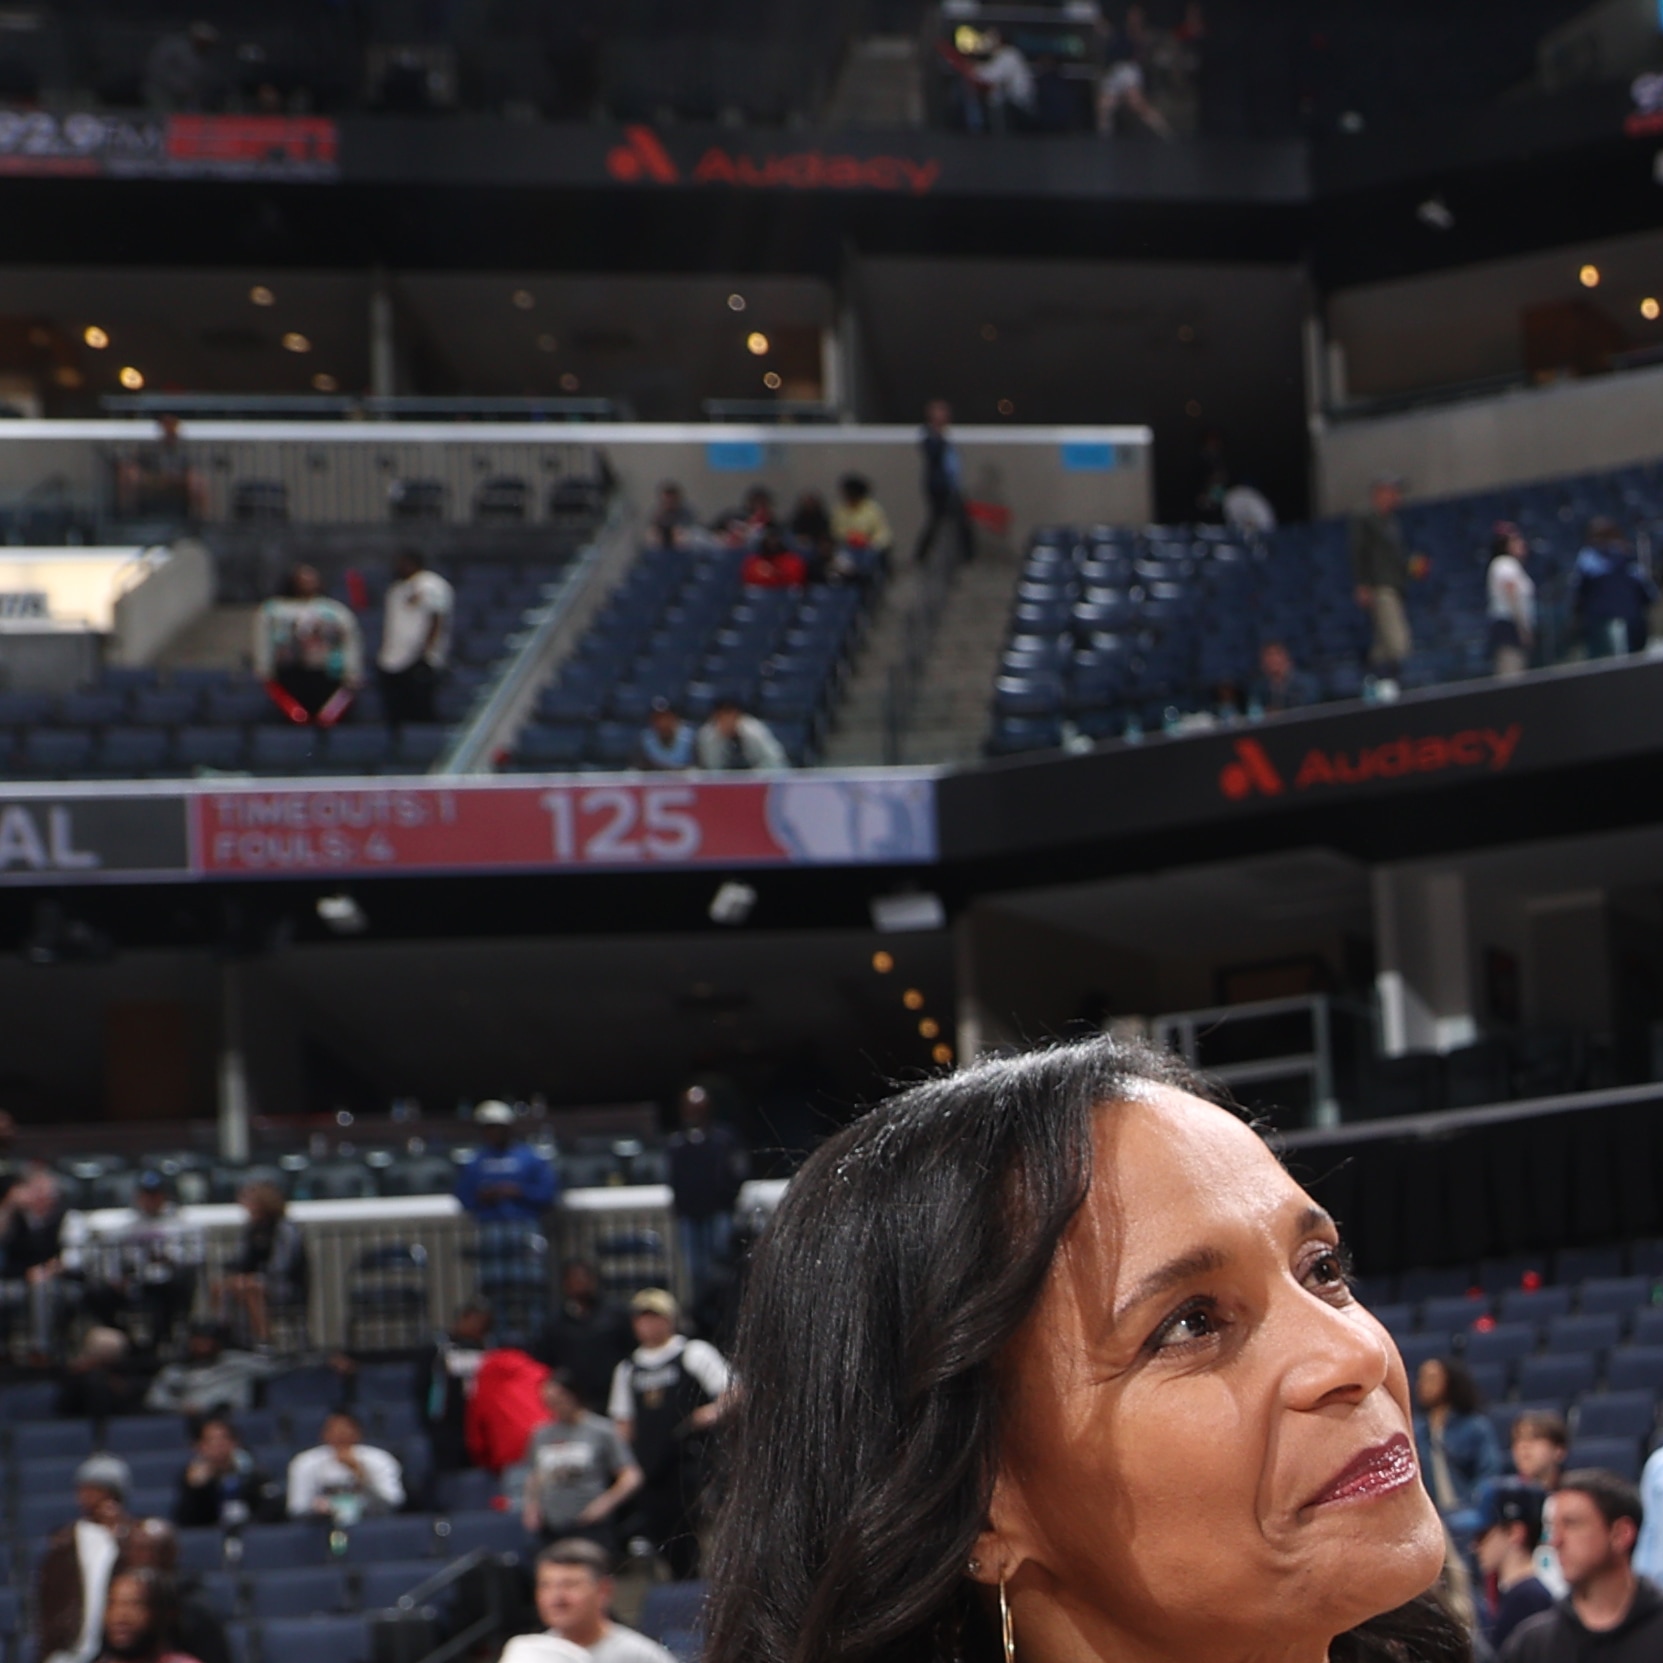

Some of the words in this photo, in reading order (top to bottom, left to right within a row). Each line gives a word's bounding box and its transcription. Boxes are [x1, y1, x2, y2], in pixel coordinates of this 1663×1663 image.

[693, 149, 941, 194] Audacy
[1294, 724, 1522, 790] Audacy
[0, 804, 99, 869] AL
[540, 786, 701, 862] 125
